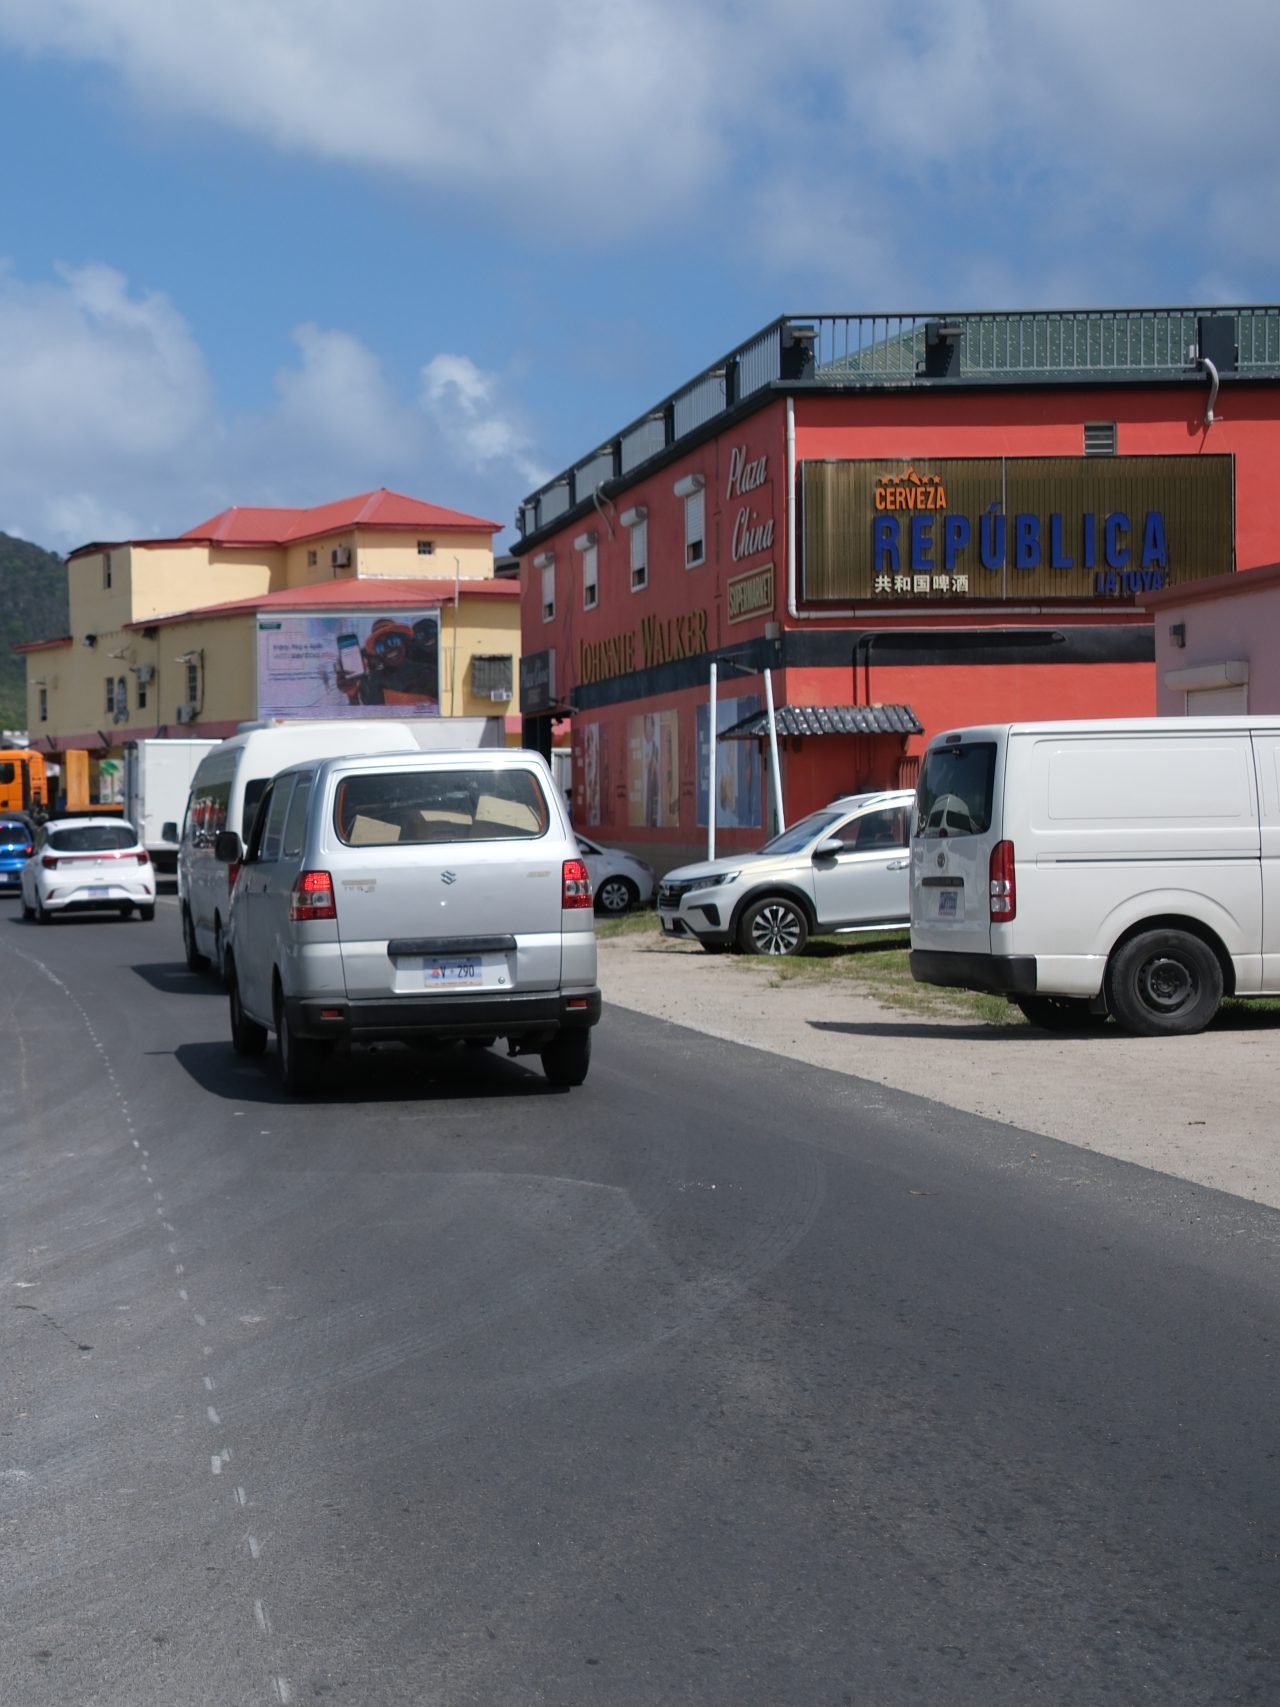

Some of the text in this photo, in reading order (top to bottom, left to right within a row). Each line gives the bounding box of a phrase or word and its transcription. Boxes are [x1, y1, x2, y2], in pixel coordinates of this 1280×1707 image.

[727, 445, 767, 500] Plaza
[875, 487, 947, 510] CERVEZA
[732, 507, 774, 562] China
[874, 502, 1168, 571] REPÚBLICA
[729, 573, 771, 616] SUPERMARKET
[875, 574, 969, 593] 共和国啤酒
[579, 631, 636, 685] JOHNNIE
[641, 608, 708, 668] WALKER
